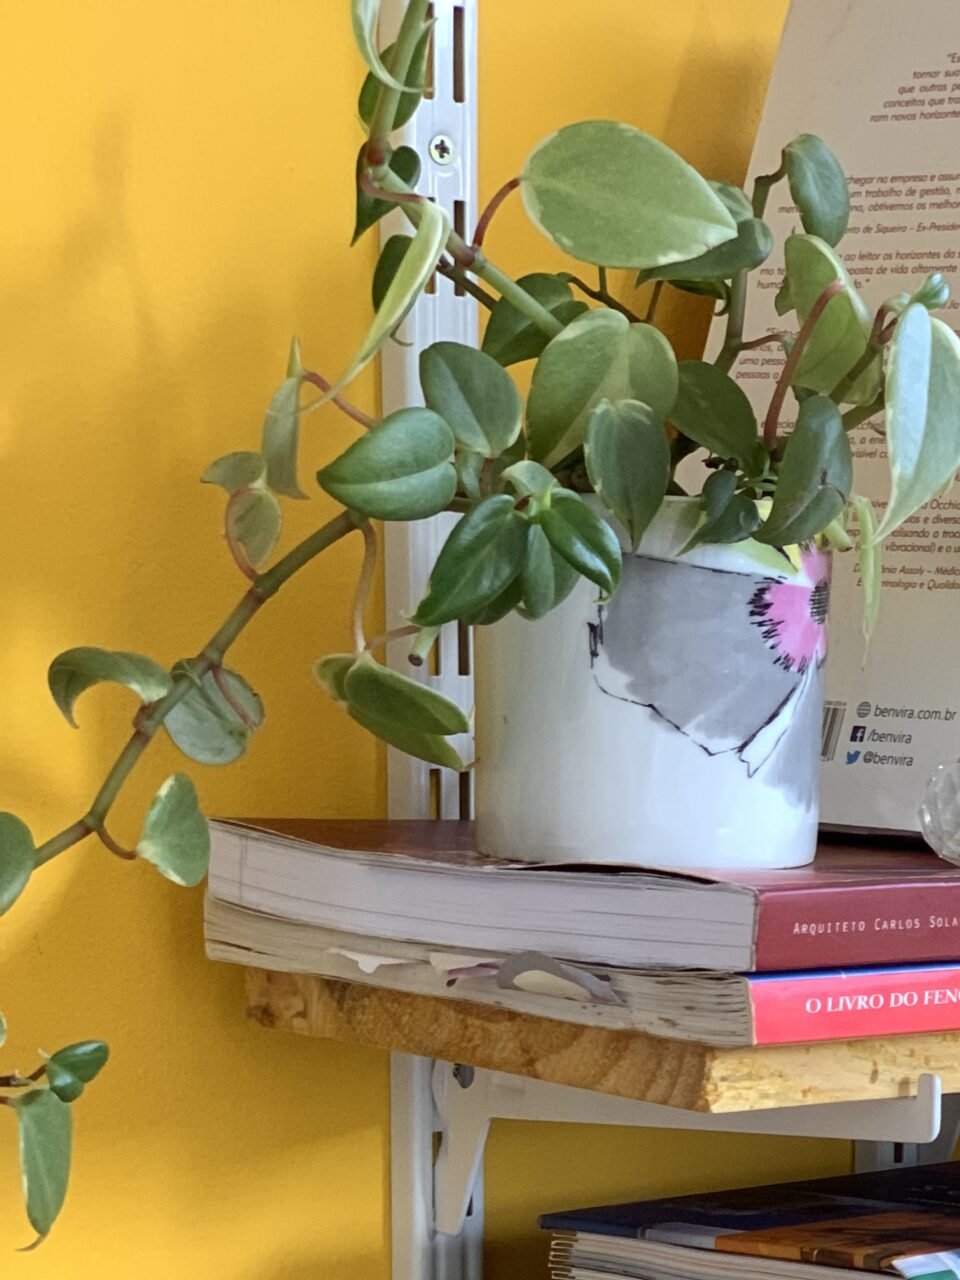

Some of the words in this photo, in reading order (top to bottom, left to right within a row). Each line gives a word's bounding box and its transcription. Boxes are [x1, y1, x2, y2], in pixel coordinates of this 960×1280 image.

[911, 70, 941, 79] tornar
[943, 68, 960, 78] sua
[896, 85, 915, 95] que
[918, 83, 947, 92] outras
[882, 97, 925, 108] conceitos
[927, 97, 945, 107] que
[869, 113, 889, 123] ram
[889, 112, 917, 121] novos
[873, 703, 957, 721] benvira.com.br
[866, 730, 912, 744] /benvira
[862, 751, 914, 767] @benvira
[793, 918, 866, 936] ARQUITETO
[873, 915, 921, 932] CARLOS
[805, 997, 822, 1014] O
[826, 992, 885, 1014] LIVRO
[889, 990, 919, 1010] DO
